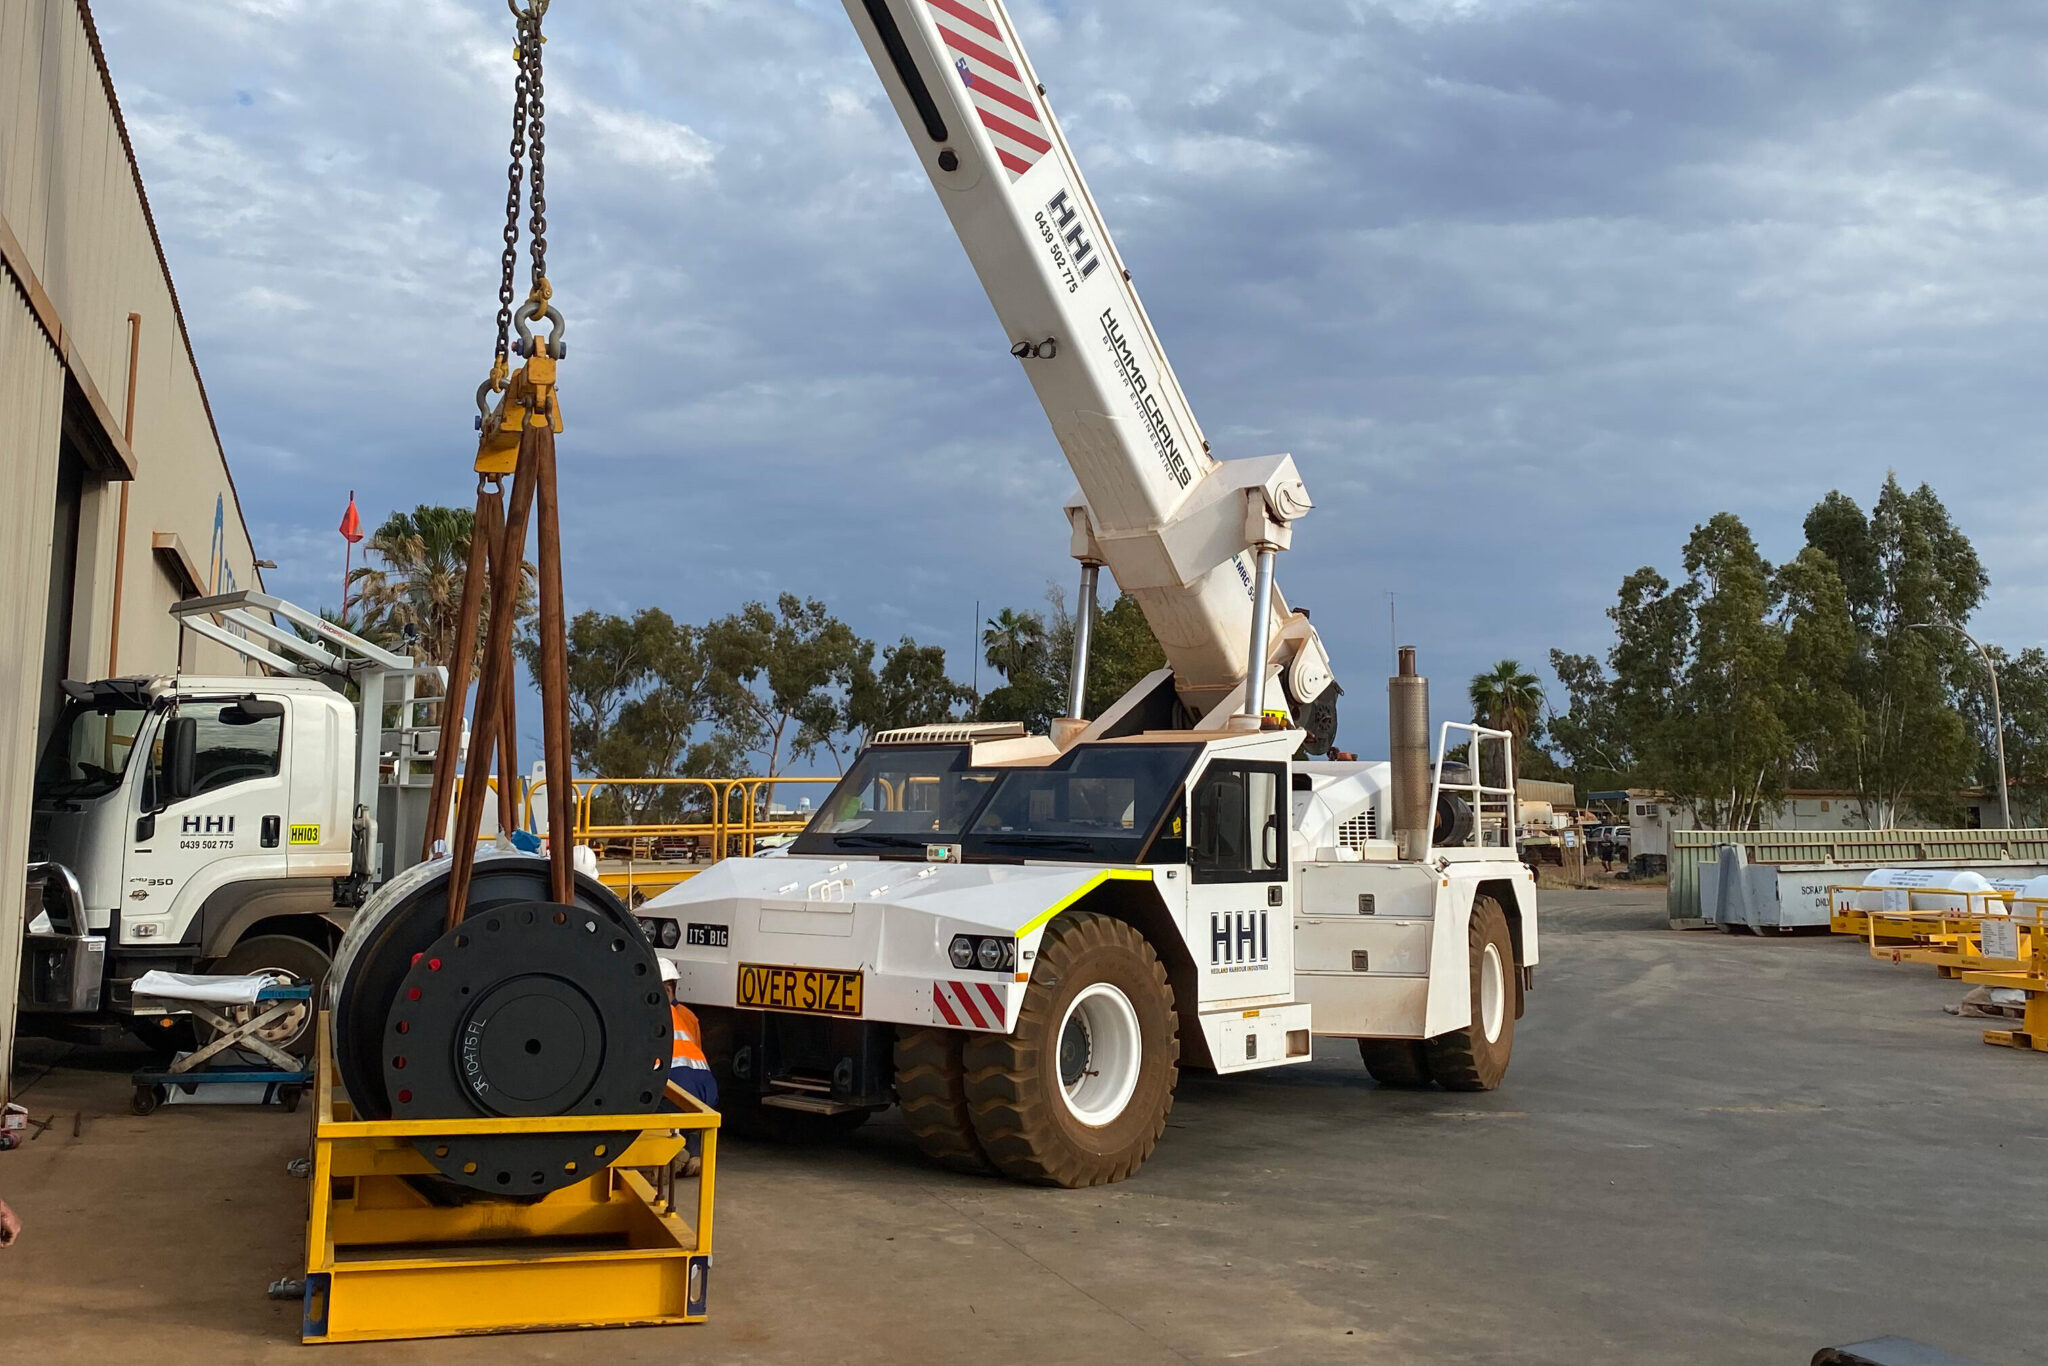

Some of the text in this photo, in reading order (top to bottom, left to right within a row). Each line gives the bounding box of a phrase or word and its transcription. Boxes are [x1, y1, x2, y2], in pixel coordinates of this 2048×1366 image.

[1034, 211, 1078, 293] 0439 502 775
[1048, 188, 1100, 280] HHI
[1102, 307, 1192, 486] HUMMA CRANES
[1102, 335, 1113, 353] BY
[1130, 392, 1174, 481] ENGINEERING
[180, 840, 234, 850] 0439 502 775
[181, 814, 236, 833] HHI
[148, 878, 174, 886] 350
[1801, 884, 1823, 895] SCRAP
[689, 928, 728, 946] ITS BIG
[1211, 910, 1268, 965] HHI
[742, 966, 857, 1012] OVER SIZE
